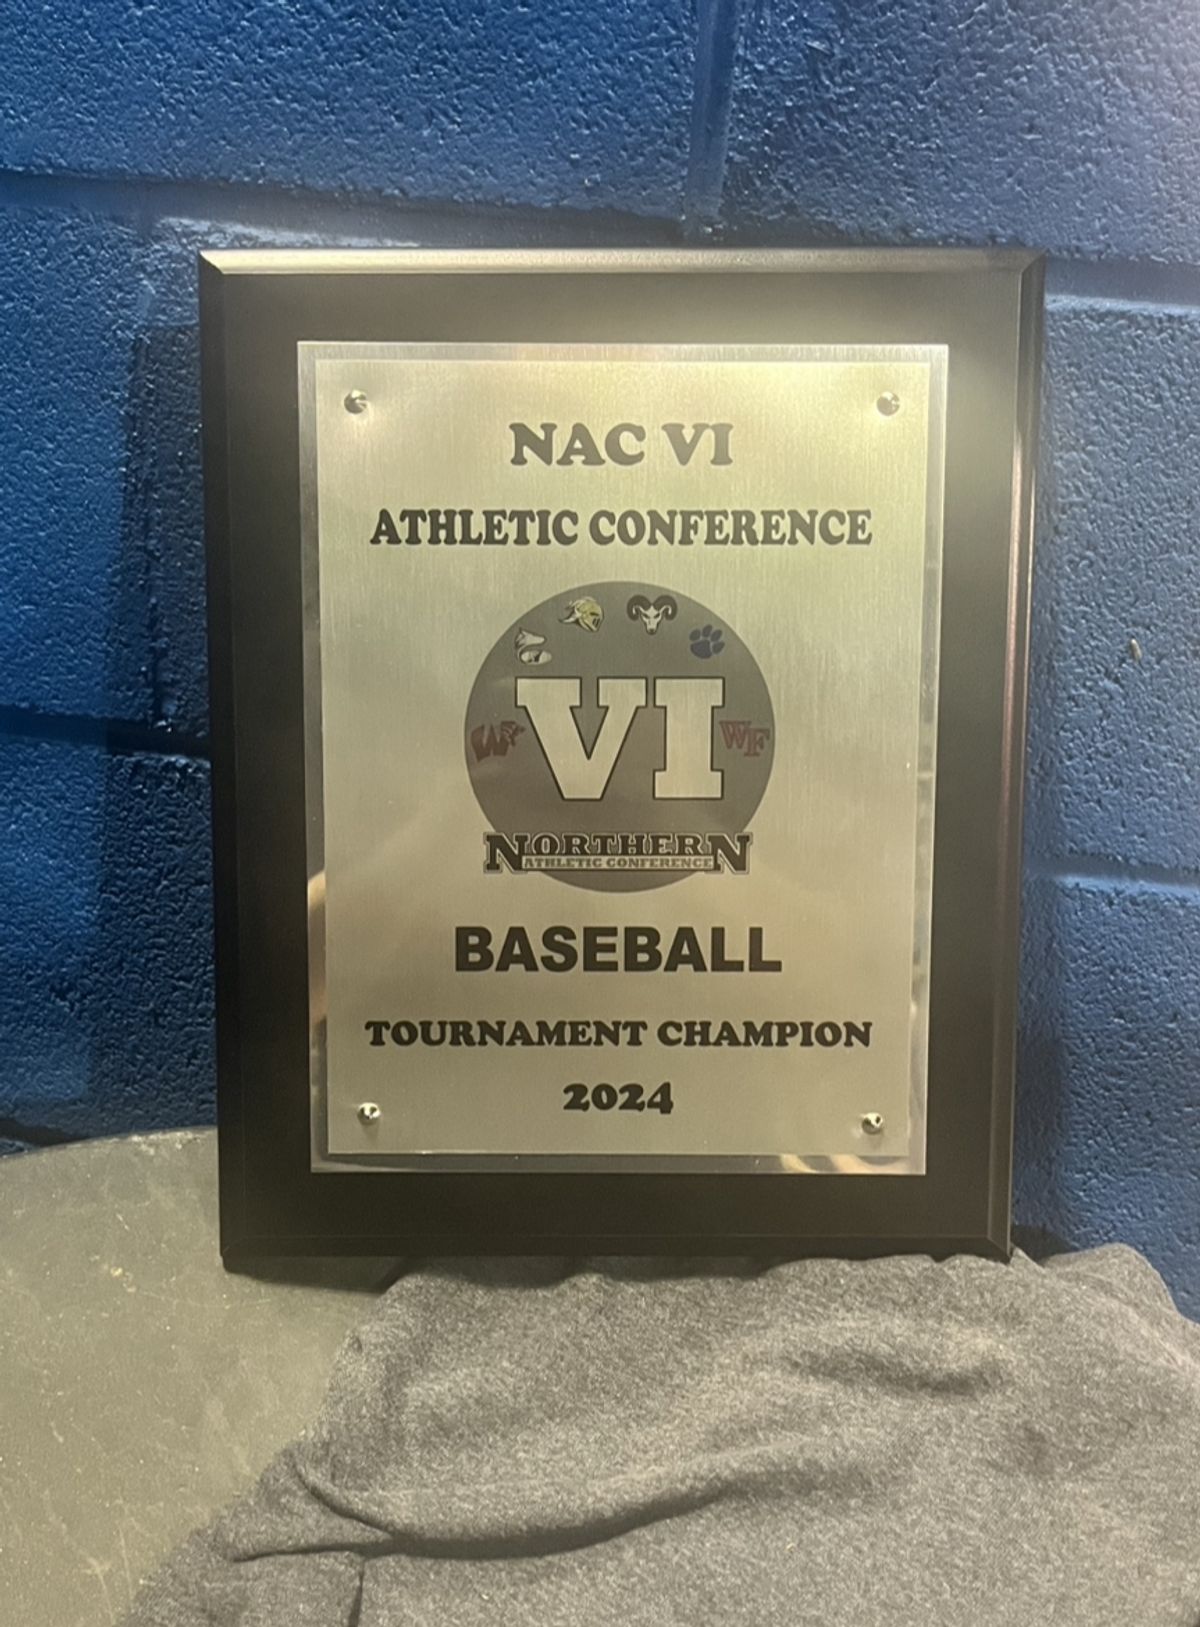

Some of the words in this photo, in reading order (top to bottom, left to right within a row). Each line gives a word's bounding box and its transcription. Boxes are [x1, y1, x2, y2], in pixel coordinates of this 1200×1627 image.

[509, 422, 646, 466] NAC
[661, 422, 733, 466] VI
[370, 508, 579, 546] ATHLETIC
[588, 508, 873, 546] CONFERENCE
[515, 676, 725, 800] VI
[484, 832, 753, 874] NORTHERN
[524, 857, 602, 869] ATHLETIC
[606, 857, 713, 869] CONFERENCE
[455, 926, 782, 972] BASEBALL
[365, 1020, 647, 1047] TOURNAMENT
[657, 1020, 873, 1048] CHAMPION
[563, 1081, 674, 1115] 2024
